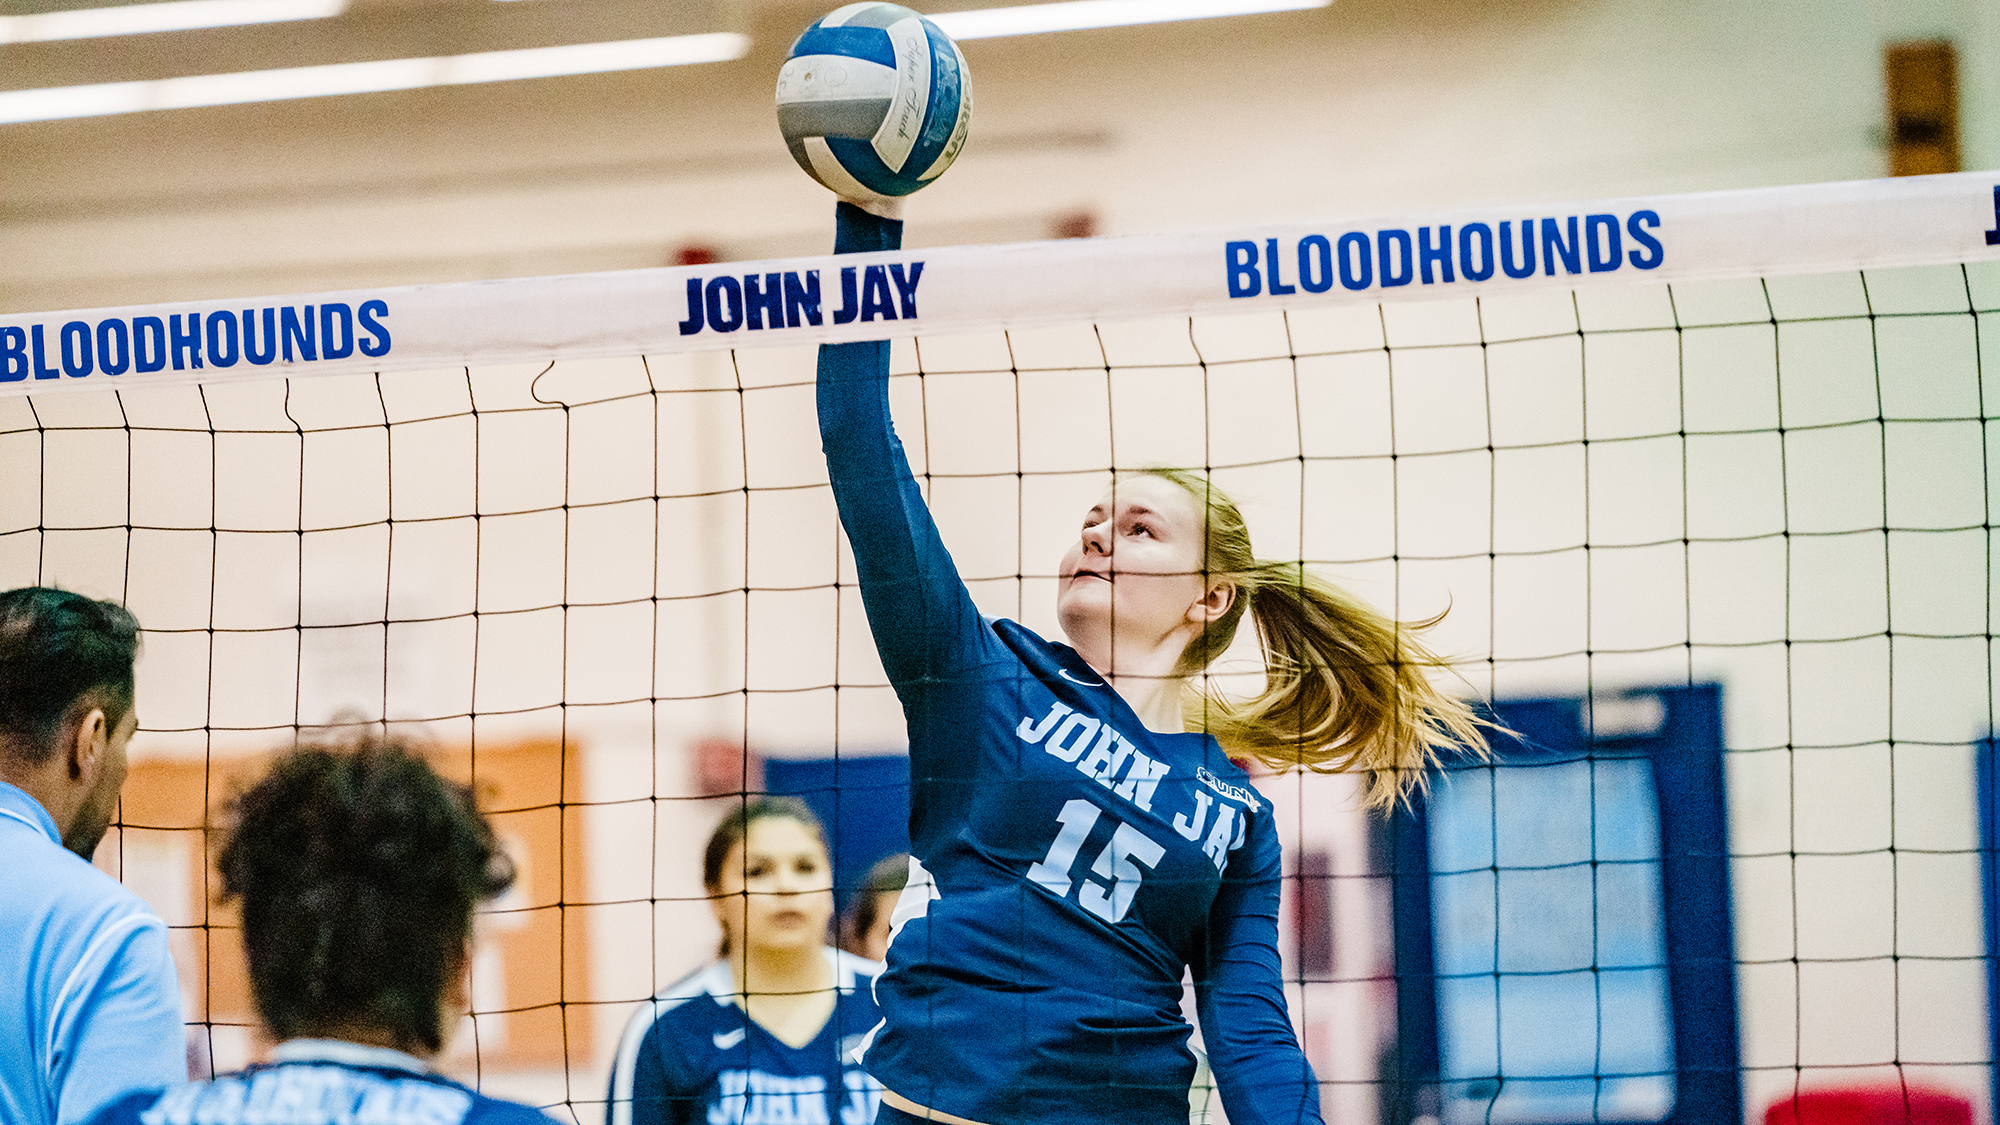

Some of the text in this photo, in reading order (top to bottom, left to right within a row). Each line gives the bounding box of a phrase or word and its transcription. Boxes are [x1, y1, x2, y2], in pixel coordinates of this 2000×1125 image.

[1225, 209, 1665, 298] BLOODHOUNDS
[0, 299, 391, 383] BLOODHOUNDS
[678, 261, 925, 336] JOHN JAY
[1016, 700, 1171, 812] JOHN
[1026, 799, 1166, 924] 15
